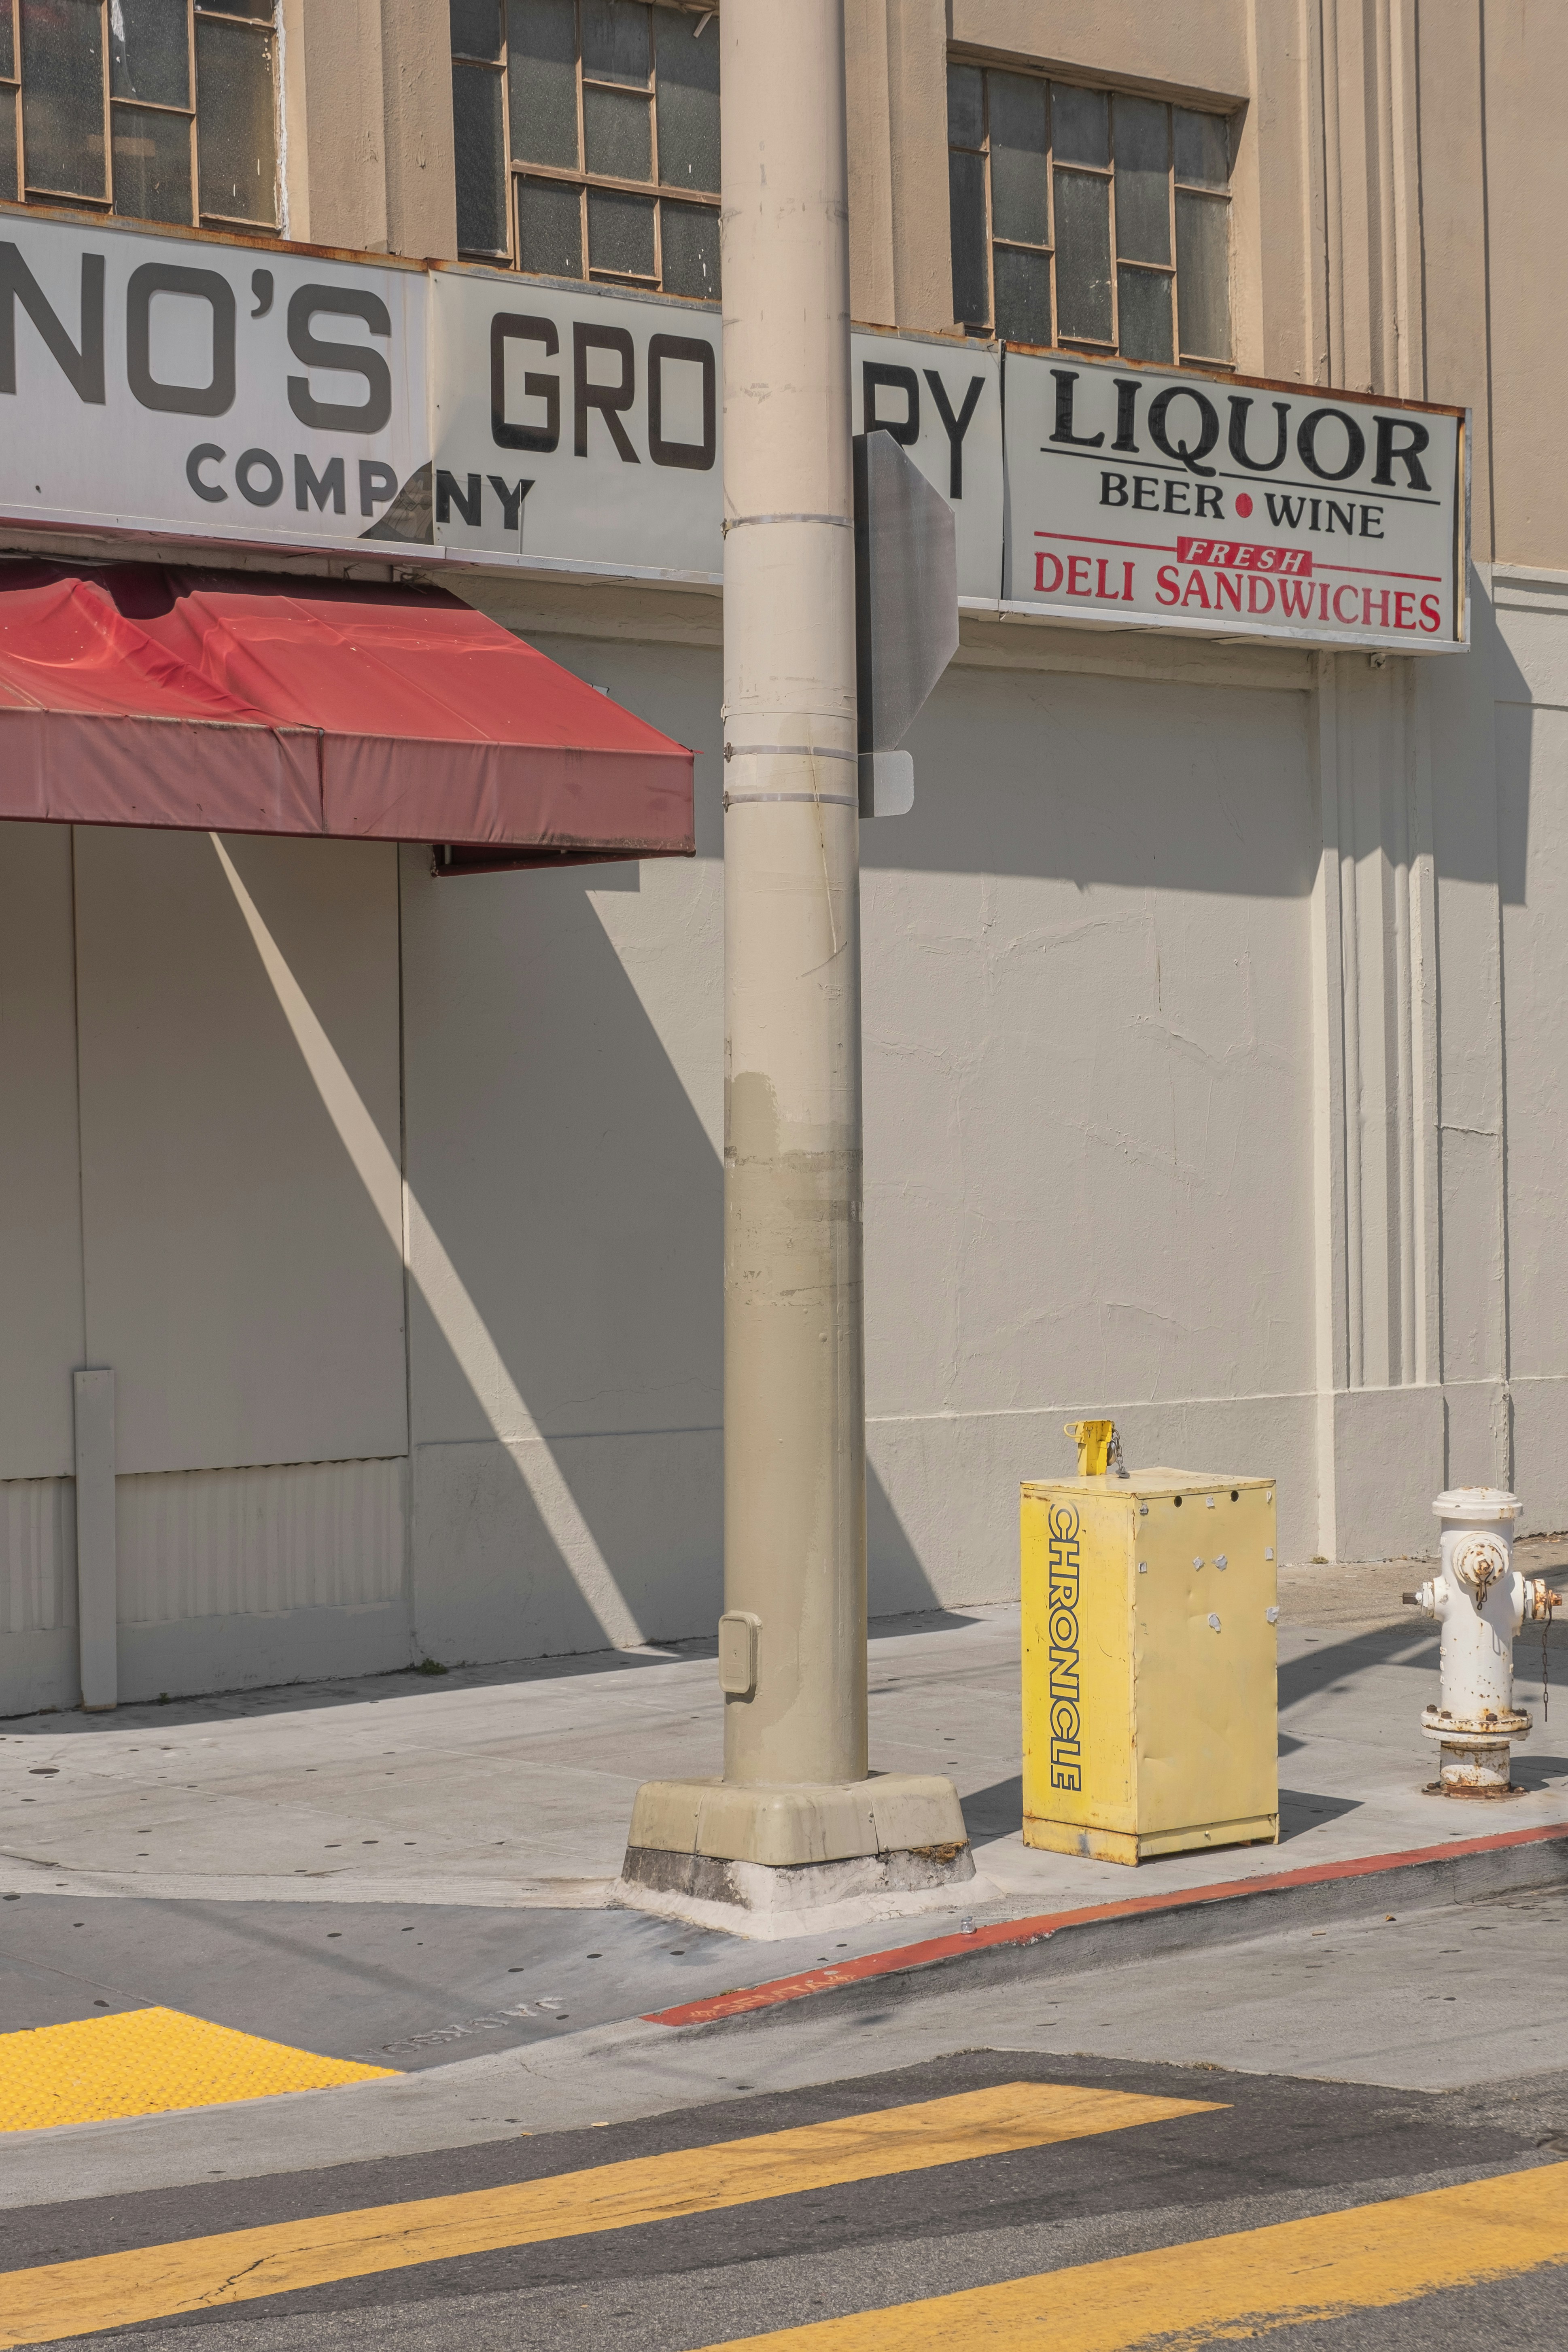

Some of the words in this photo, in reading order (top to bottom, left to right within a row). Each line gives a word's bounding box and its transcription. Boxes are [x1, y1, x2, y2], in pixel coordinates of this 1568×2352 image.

[490, 312, 985, 500] GRORY
[1049, 369, 1431, 491] LIQUOR
[186, 443, 535, 530] COMPNY
[1099, 471, 1224, 520] BEER
[1264, 493, 1384, 539] WINE
[1033, 551, 1135, 601] DELI
[1155, 565, 1441, 633] SANDWICHES
[1186, 541, 1305, 573] FRESH
[1048, 1501, 1082, 1792] CHRONICLE
